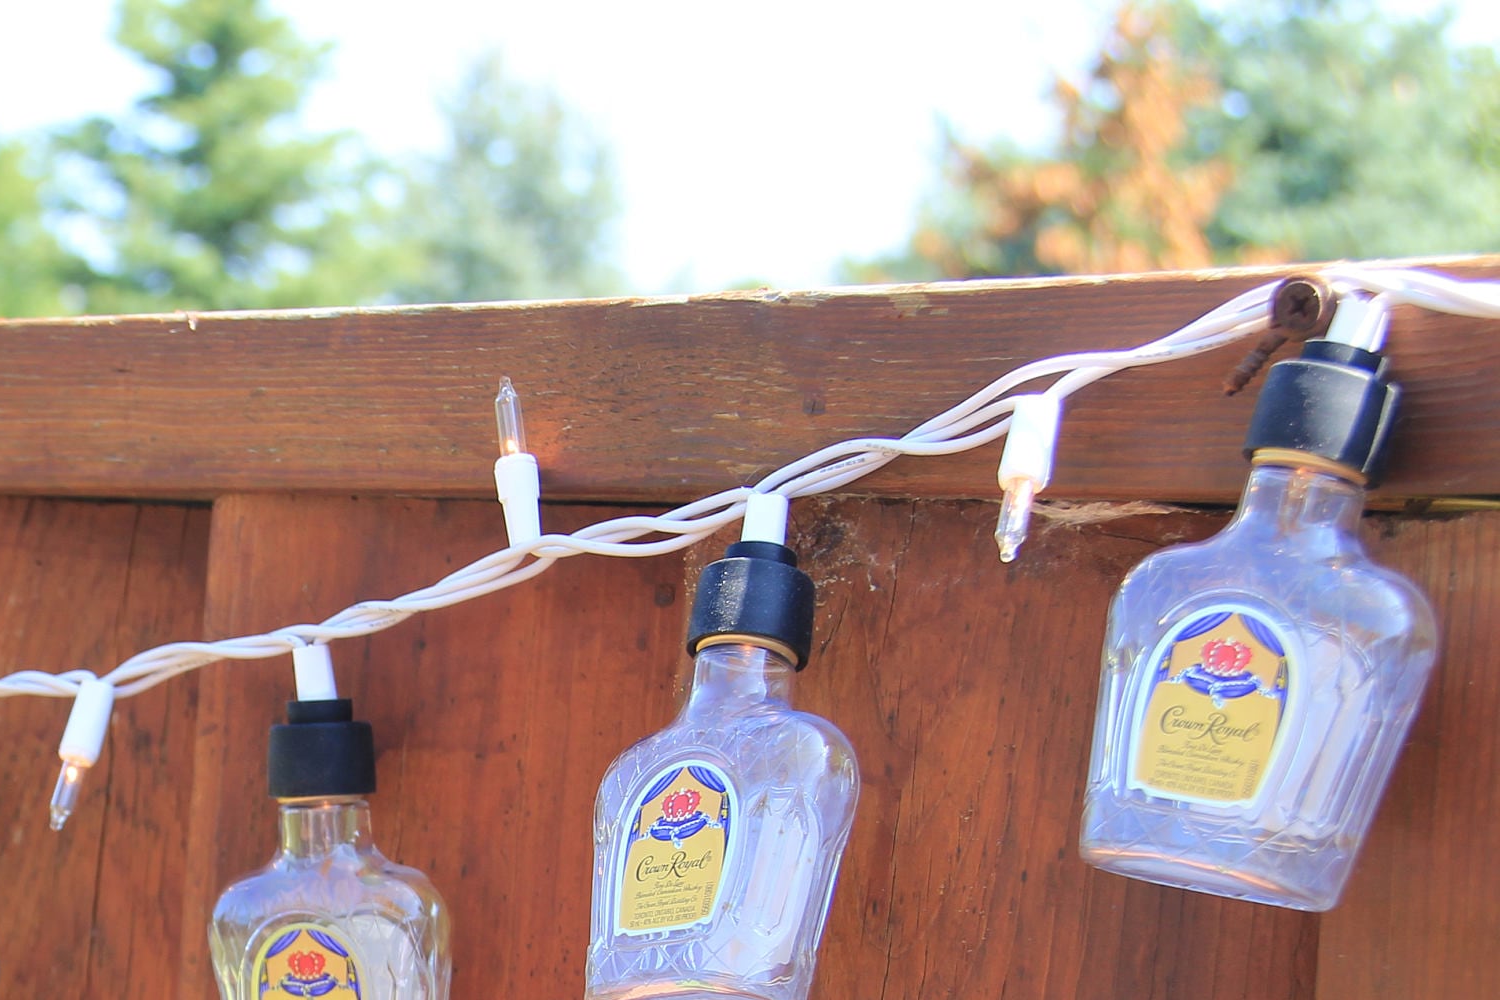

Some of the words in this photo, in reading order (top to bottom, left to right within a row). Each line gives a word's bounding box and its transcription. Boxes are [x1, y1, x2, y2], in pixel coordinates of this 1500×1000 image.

[1160, 705, 1204, 735] Crown
[1190, 712, 1260, 746] Royal
[636, 855, 670, 882] Crown
[658, 850, 712, 879] Royal
